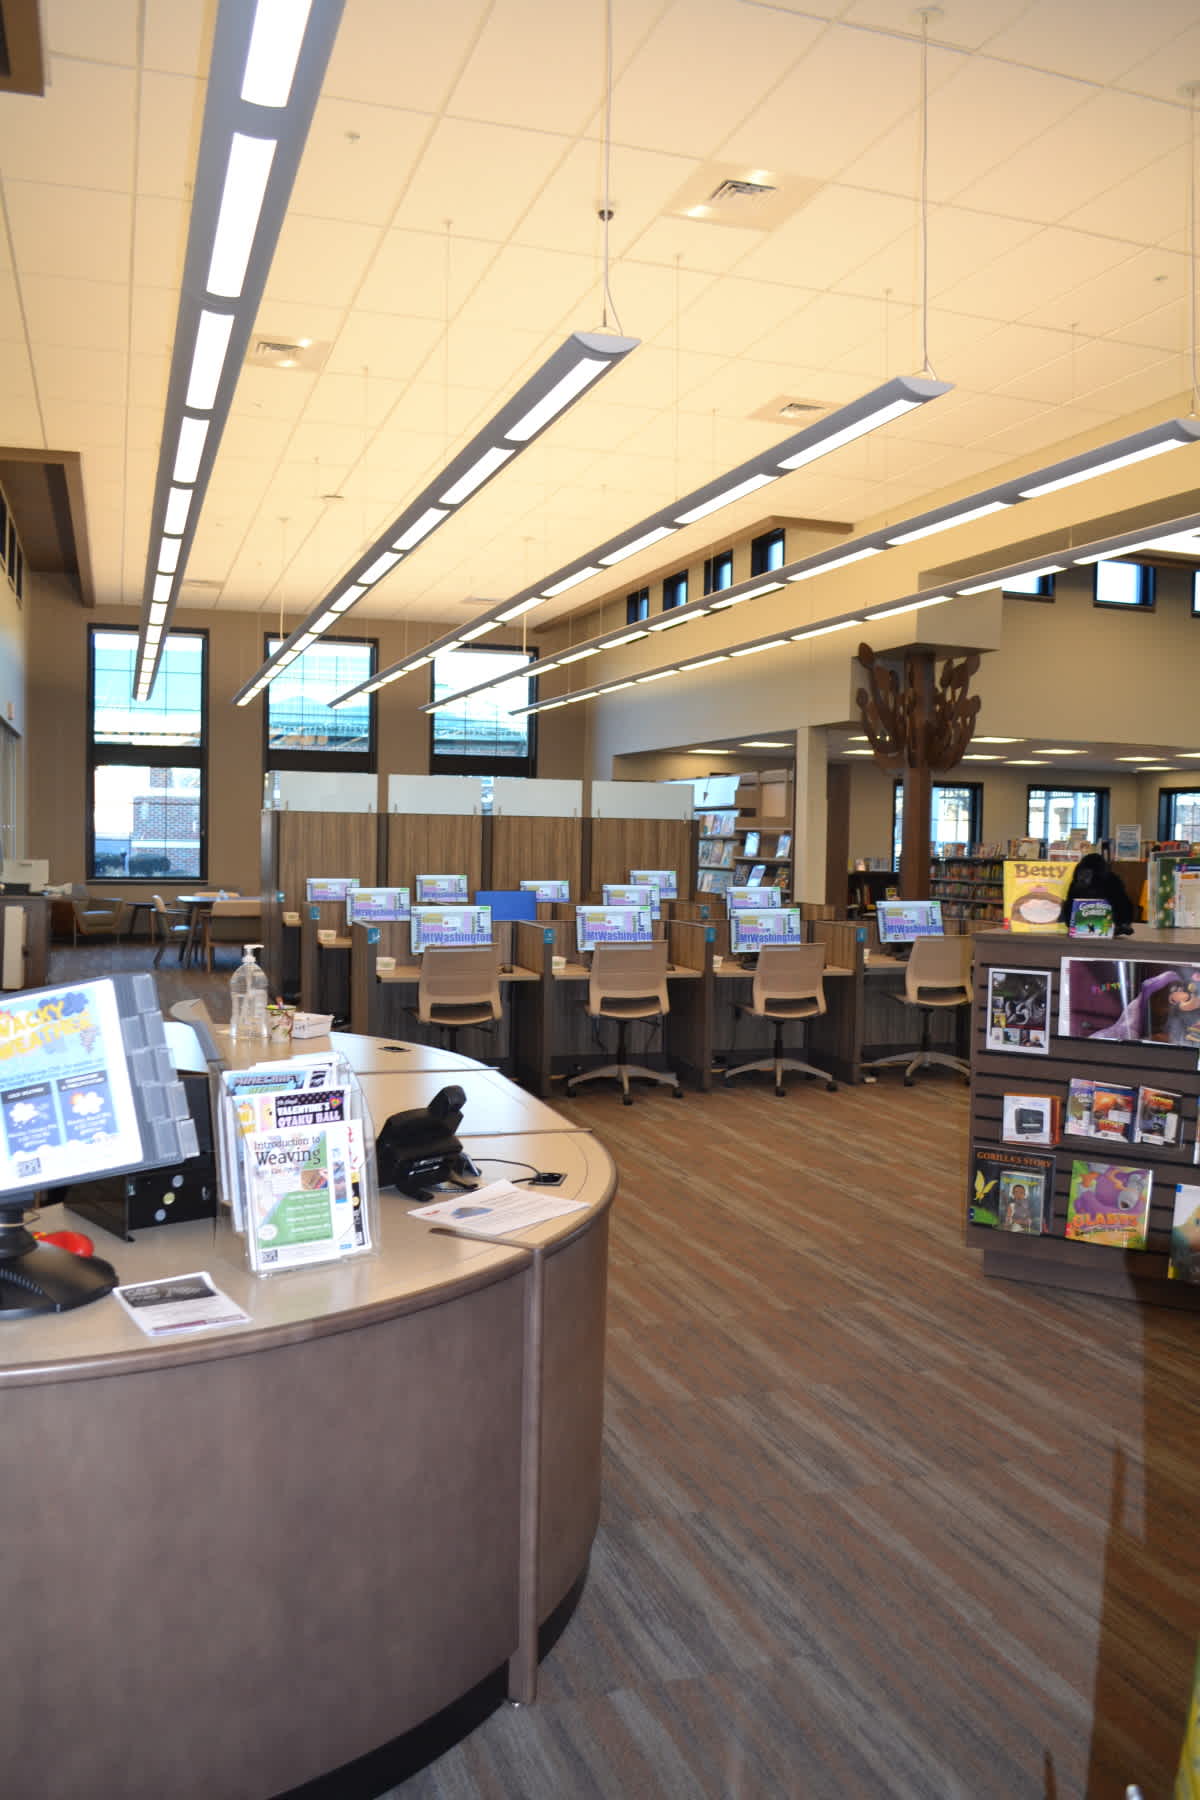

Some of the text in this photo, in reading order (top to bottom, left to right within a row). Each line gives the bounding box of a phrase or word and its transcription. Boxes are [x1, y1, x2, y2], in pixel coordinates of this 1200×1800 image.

[1014, 863, 1068, 878] Betty
[422, 933, 492, 944] MtWashington
[234, 1074, 297, 1087] MINECRAFT
[277, 1101, 330, 1116] VALENTINE'S
[277, 1110, 340, 1128] OTAKU BALL
[254, 1136, 321, 1150] Introduction to
[255, 1147, 321, 1166] Weaving
[1023, 1159, 1052, 1168] STORY
